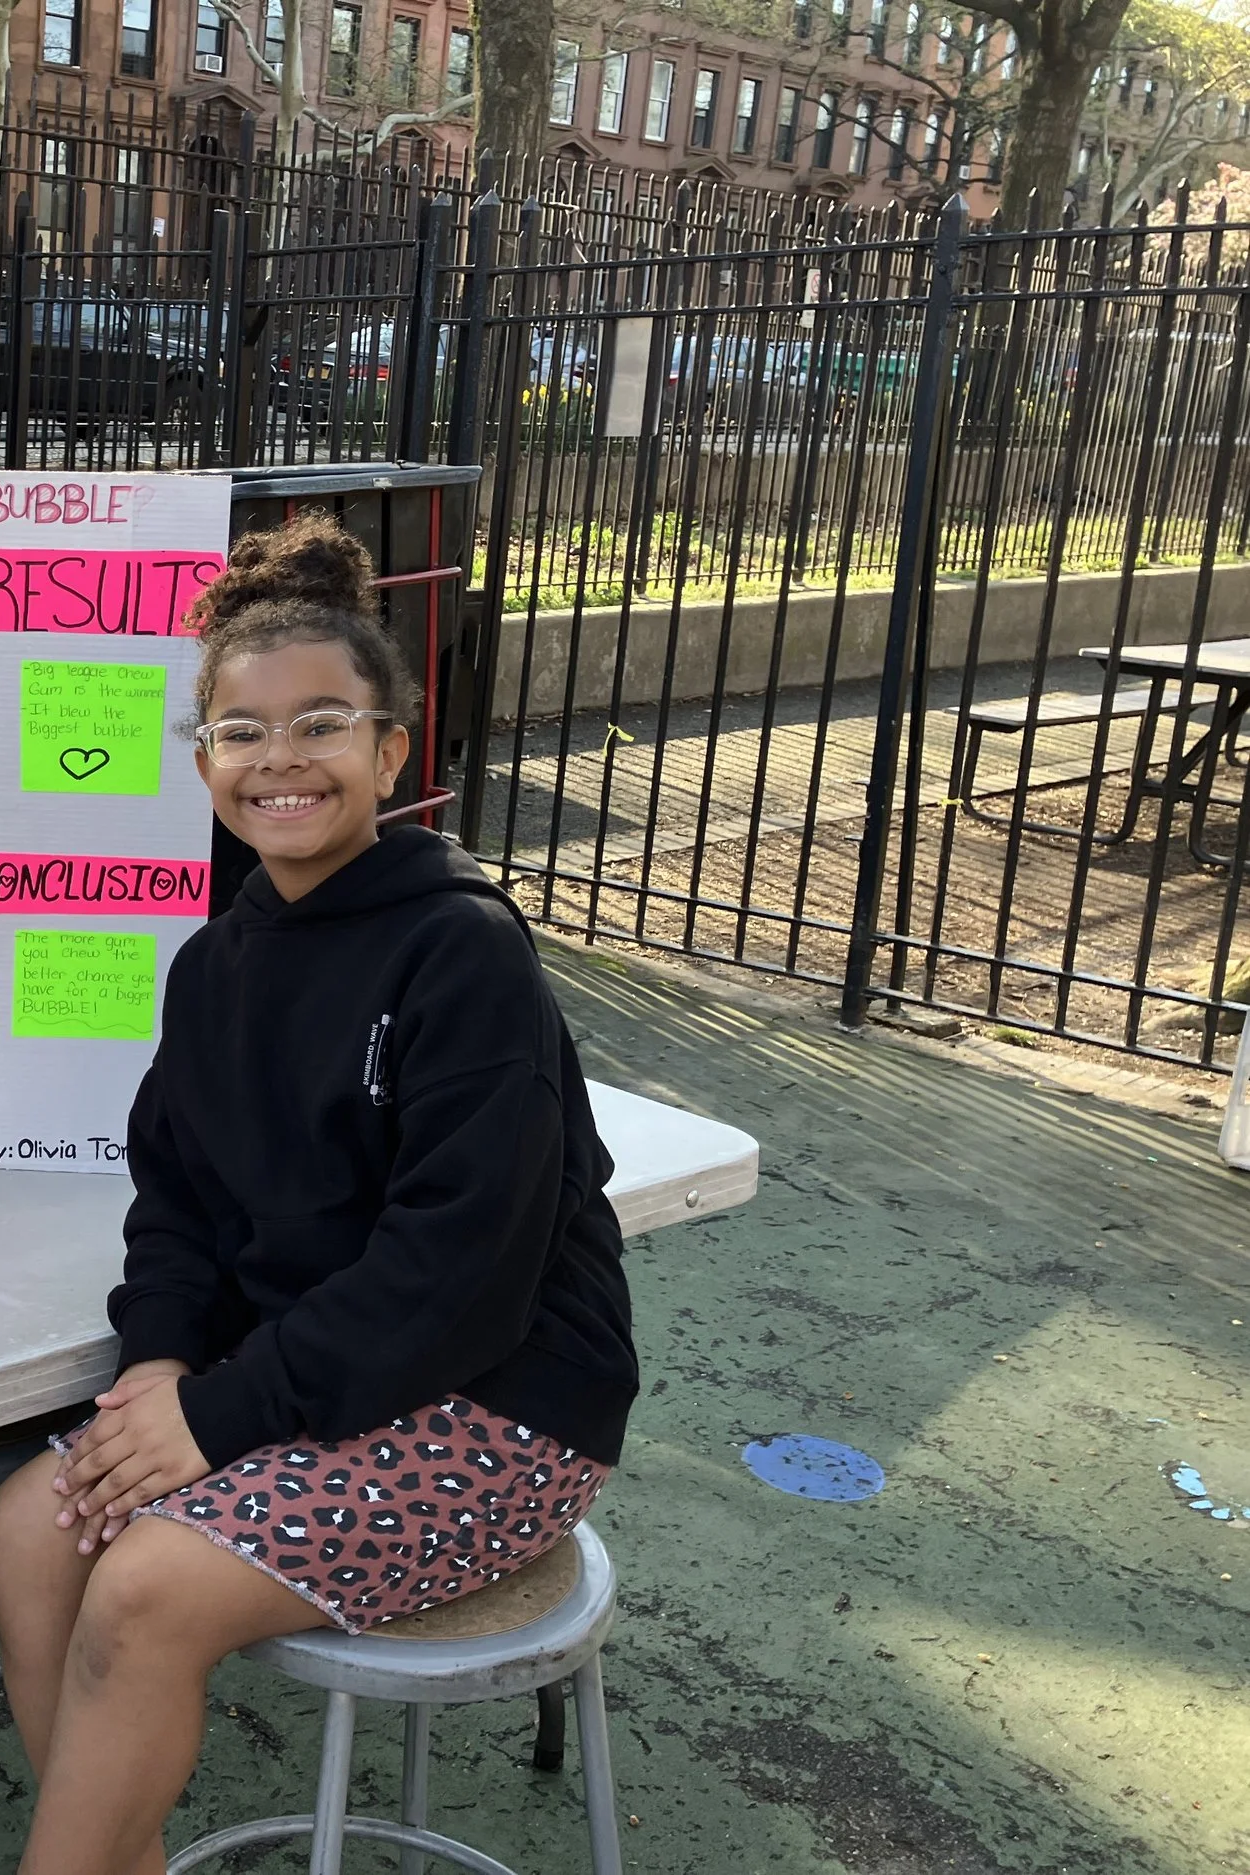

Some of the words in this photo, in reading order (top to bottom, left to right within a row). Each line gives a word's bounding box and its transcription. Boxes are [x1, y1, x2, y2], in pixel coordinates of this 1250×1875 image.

[74, 685, 87, 696] is
[100, 682, 123, 698] the
[59, 704, 91, 718] blew
[103, 705, 126, 720] the
[28, 720, 82, 740] Biggest
[93, 722, 143, 739] bubble
[59, 933, 96, 945] more
[104, 936, 137, 951] gum
[22, 948, 49, 965] you
[112, 947, 141, 961] the
[22, 965, 67, 981] better
[76, 968, 125, 984] chance
[130, 973, 155, 988] you
[21, 982, 56, 996] have
[65, 981, 88, 998] for
[98, 987, 109, 998] a
[115, 987, 155, 1005] bigger
[17, 997, 98, 1018] BUBBLE!
[369, 1023, 379, 1043] WAVE
[16, 1138, 77, 1160] Olivia
